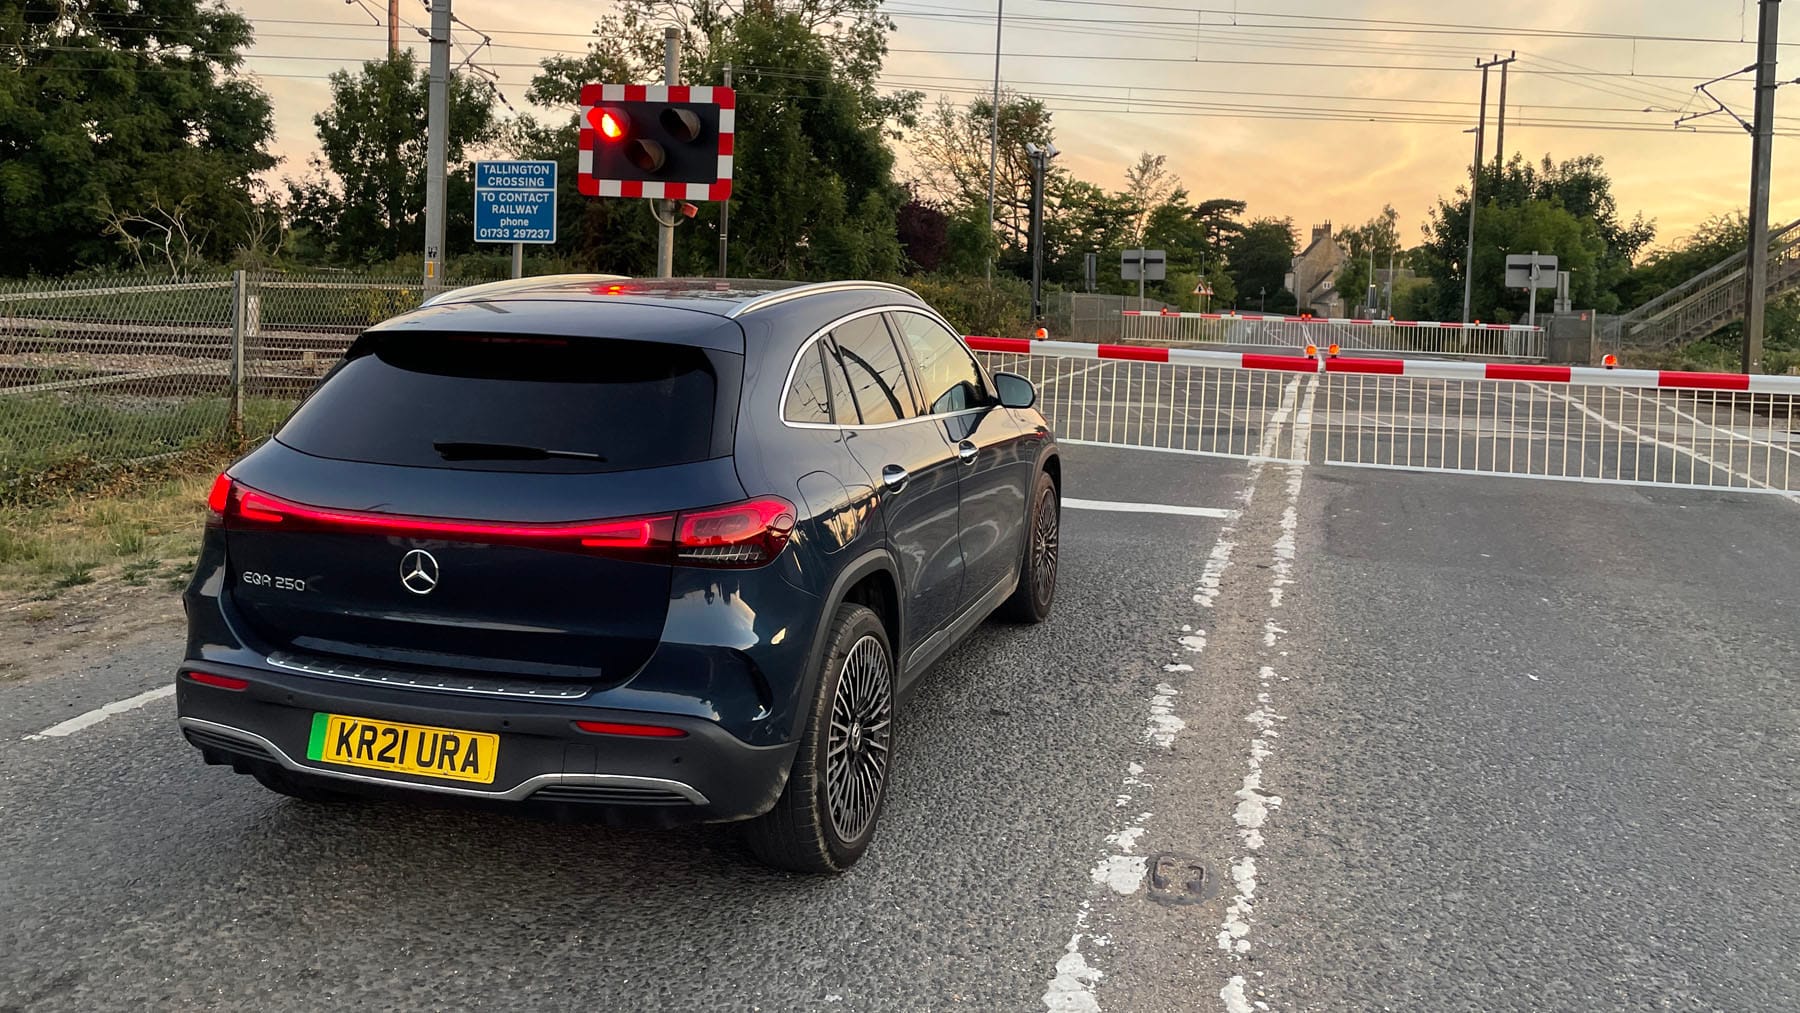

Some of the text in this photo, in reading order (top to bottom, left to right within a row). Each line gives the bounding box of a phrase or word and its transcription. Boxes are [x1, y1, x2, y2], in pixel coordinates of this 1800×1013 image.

[483, 164, 550, 175] TALLINGTON
[488, 176, 545, 187] CROSSING
[481, 192, 549, 203] TO CONTACT
[491, 204, 539, 215] RAILWAY
[500, 216, 529, 228] phone
[480, 228, 550, 239] 01733 297237
[243, 571, 306, 592] EQA 250
[335, 721, 480, 774] KR21 URA
